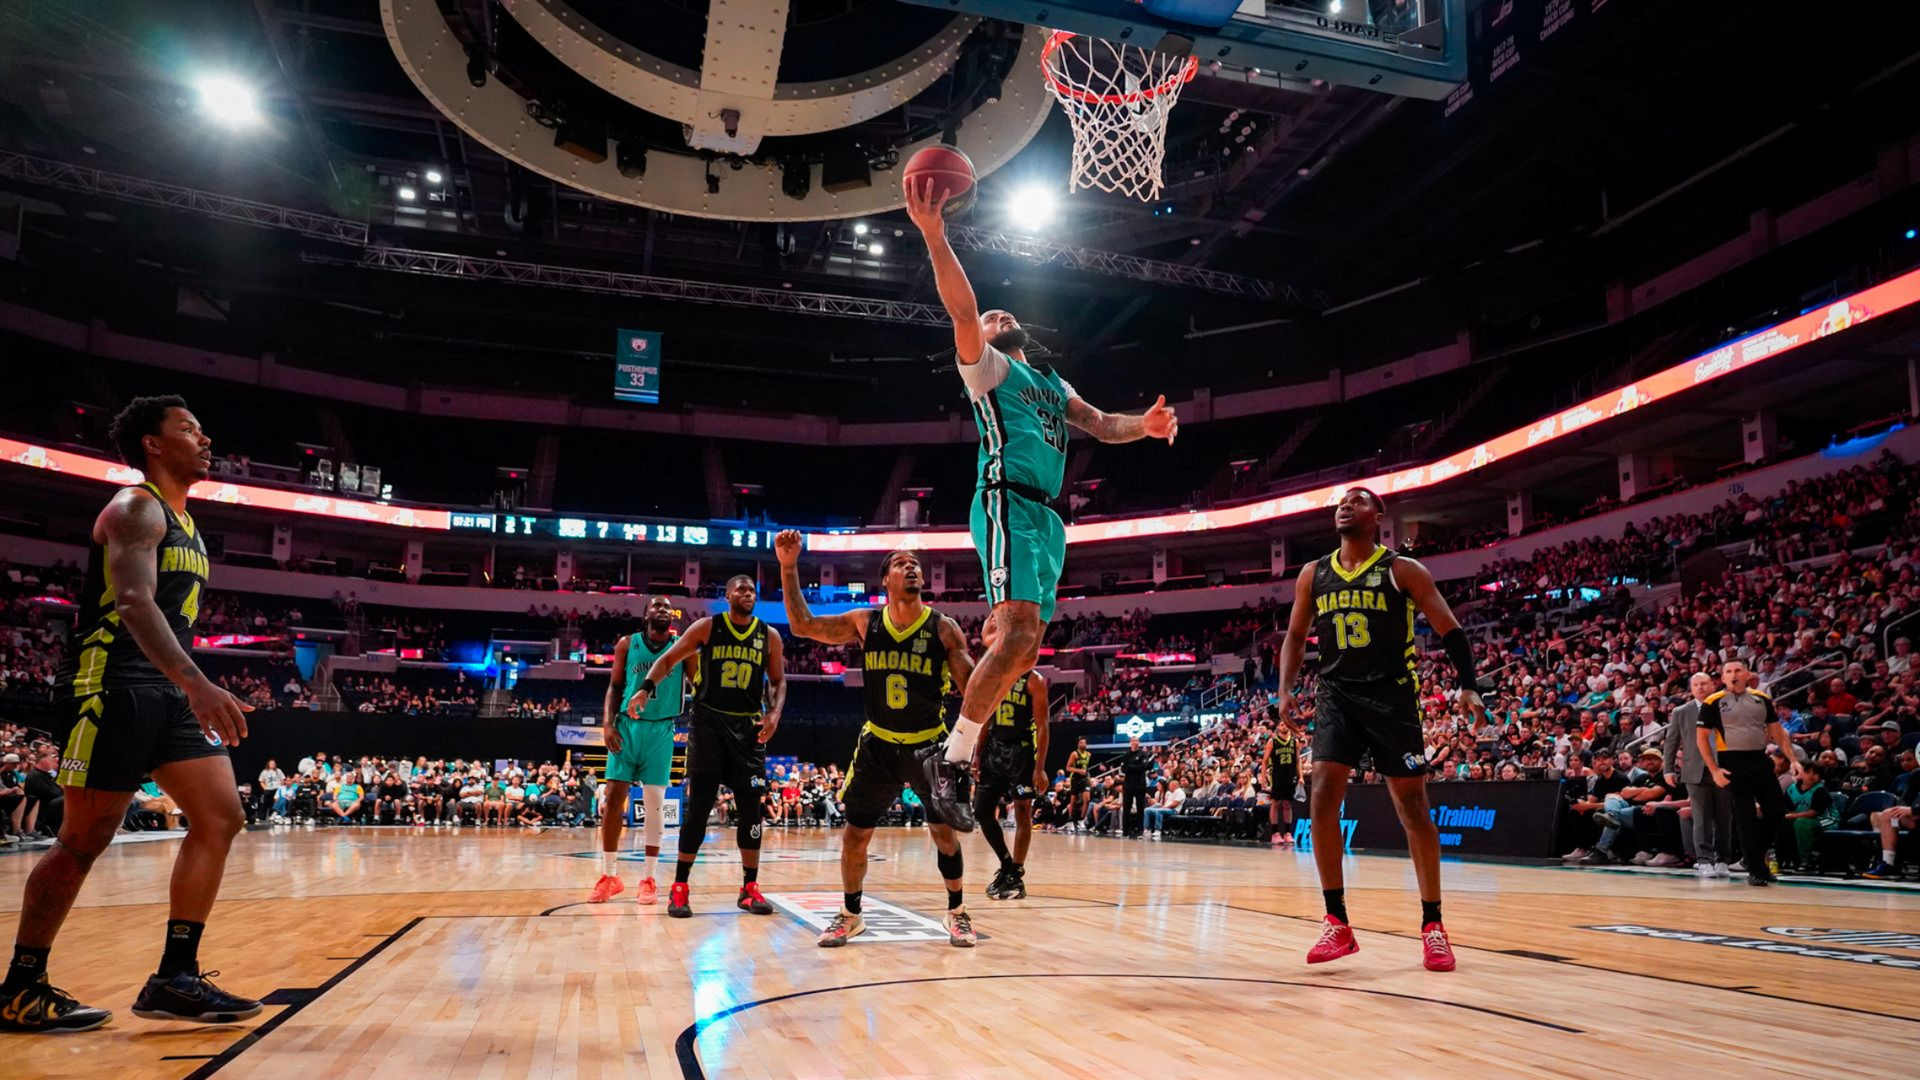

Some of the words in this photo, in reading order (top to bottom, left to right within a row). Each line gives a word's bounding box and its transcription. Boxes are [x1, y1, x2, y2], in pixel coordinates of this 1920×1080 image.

[618, 363, 658, 375] POSTHUMUS
[630, 373, 645, 387] 33
[1036, 407, 1066, 454] 20
[476, 517, 491, 528] PM
[598, 522, 609, 538] 7
[657, 525, 677, 542] 13
[1316, 589, 1388, 617] NIAGARA
[1332, 612, 1371, 650] 13
[712, 645, 763, 667] NIAGARA
[865, 650, 933, 676] NIAGARA
[721, 660, 753, 690] 20
[885, 673, 908, 709] 6
[996, 703, 1015, 727] 12
[61, 758, 87, 772] NRL
[1280, 753, 1292, 765] 23
[1437, 805, 1496, 831] Training
